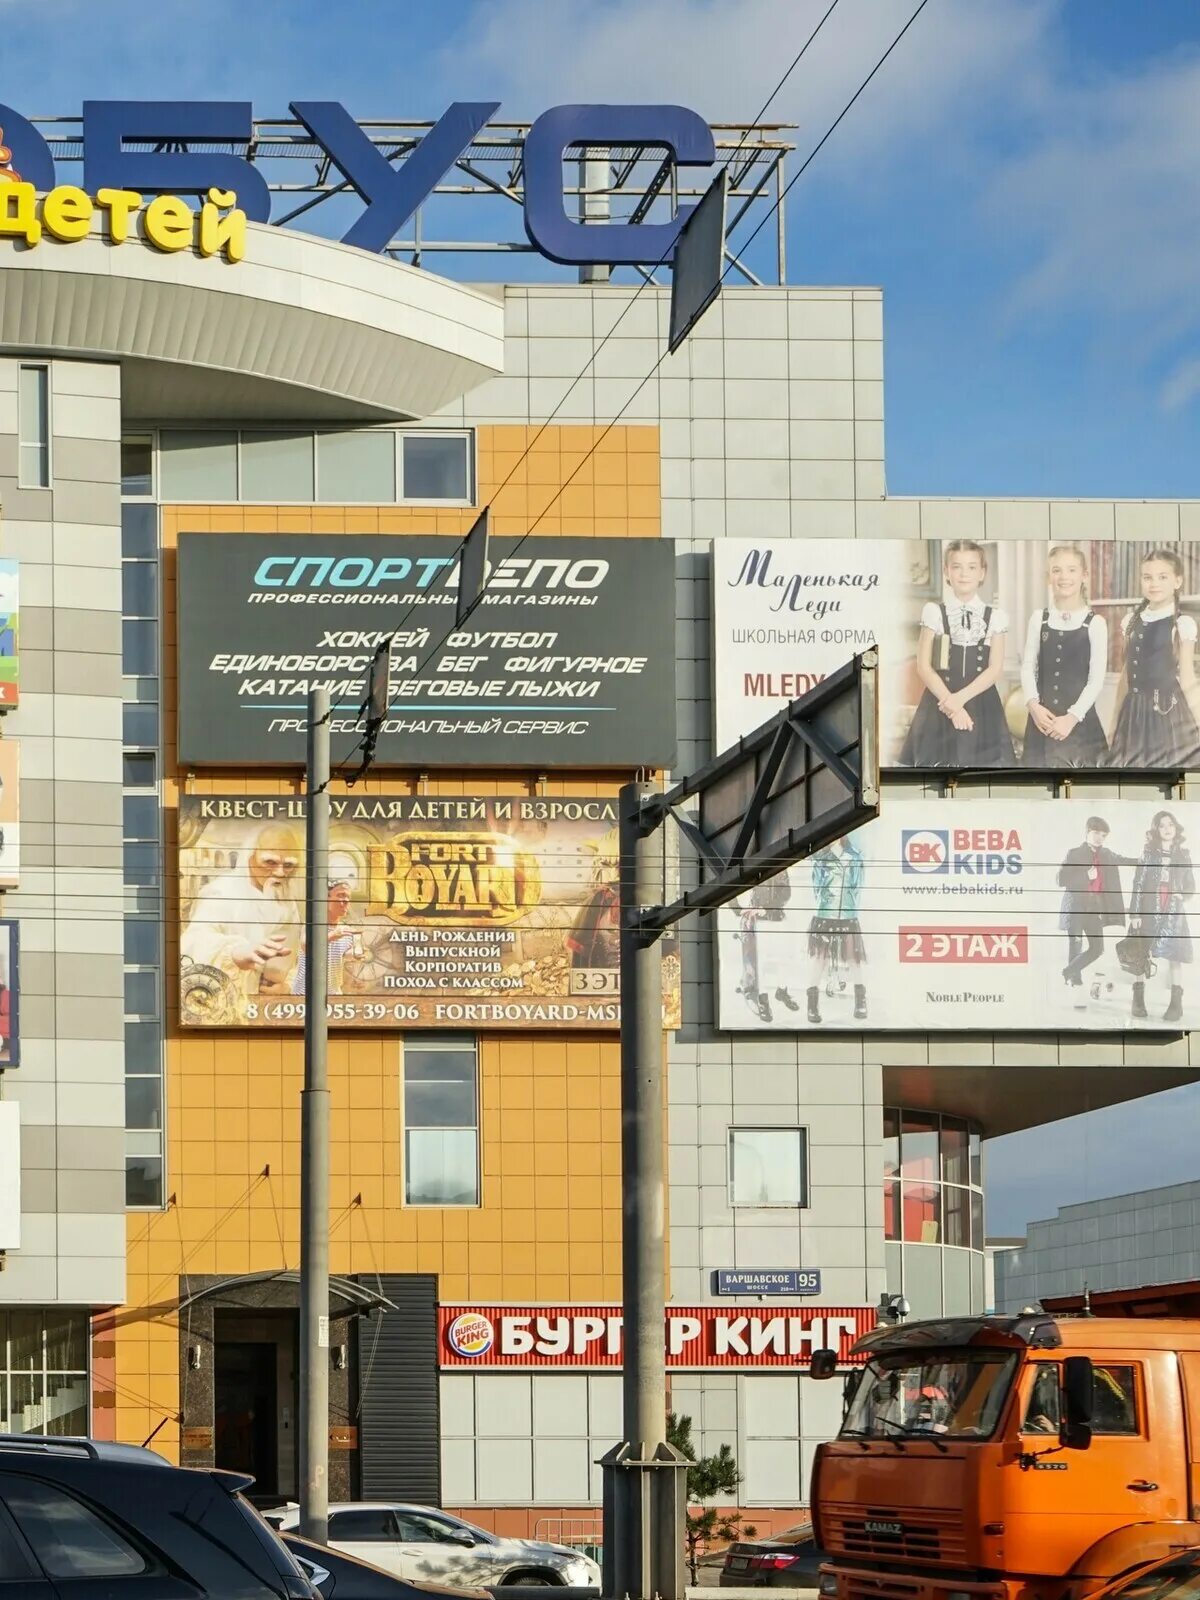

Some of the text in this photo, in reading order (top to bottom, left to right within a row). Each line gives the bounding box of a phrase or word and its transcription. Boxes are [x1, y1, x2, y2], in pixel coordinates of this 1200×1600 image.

[248, 593, 599, 606] ПРОФЕССИОНАЛЬНЫ МАГАЗИНЫ
[316, 627, 559, 649] ХОККЕЙ ФУТБОЛ
[732, 629, 876, 644] ШКОЛЬНАЯ ФОРМА
[209, 654, 648, 674] ЕДИНОБОРСВА БЕГ ФИГУРНОЕ
[506, 680, 602, 698] ЛЫЖИ
[502, 720, 590, 735] СЕРВИС
[200, 797, 617, 820] КВЕСТ-ШУ ДЛЯ ДЕТЕЙ И ВЗРОСЛ
[410, 843, 494, 861] FORT
[909, 829, 1023, 863] BK BEBA
[953, 853, 1023, 875] KIDS
[902, 883, 1024, 895] www.bebakids.ru
[905, 934, 1020, 958] 2 ЭТАЖ
[575, 971, 620, 990] 3 ЭТ
[246, 1004, 258, 1020] 8
[263, 1003, 306, 1021] (499
[725, 1273, 817, 1287] ВАРШАВСКОЕ 95
[455, 1320, 488, 1338] BURGER
[456, 1328, 489, 1348] KING
[501, 1315, 856, 1356] БУРГР КИНГ
[864, 1520, 902, 1534] KAMAZ
